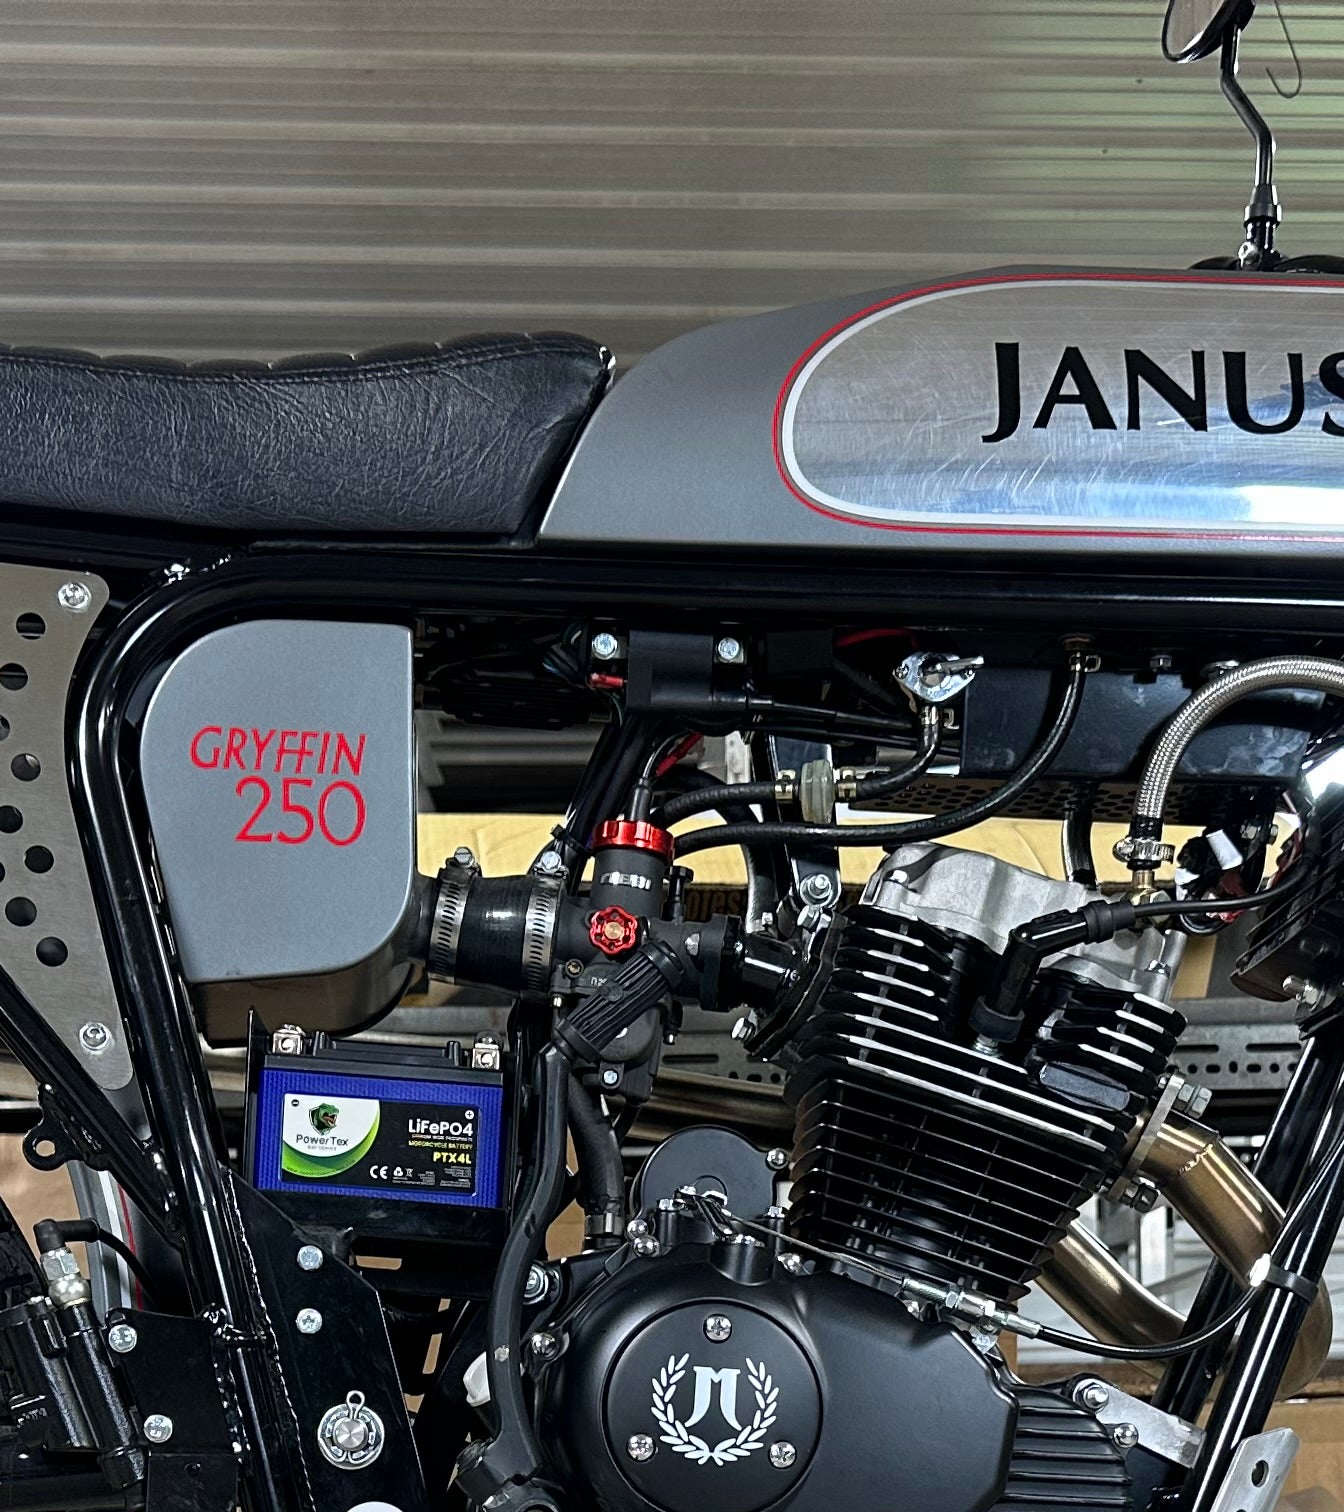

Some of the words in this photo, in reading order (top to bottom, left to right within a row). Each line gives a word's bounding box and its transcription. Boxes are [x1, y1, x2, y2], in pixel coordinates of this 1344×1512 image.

[189, 725, 367, 776] GRYFFIN
[233, 774, 367, 846] 250
[408, 1118, 473, 1136] LiFePO4
[433, 1151, 472, 1164] PTX4L
